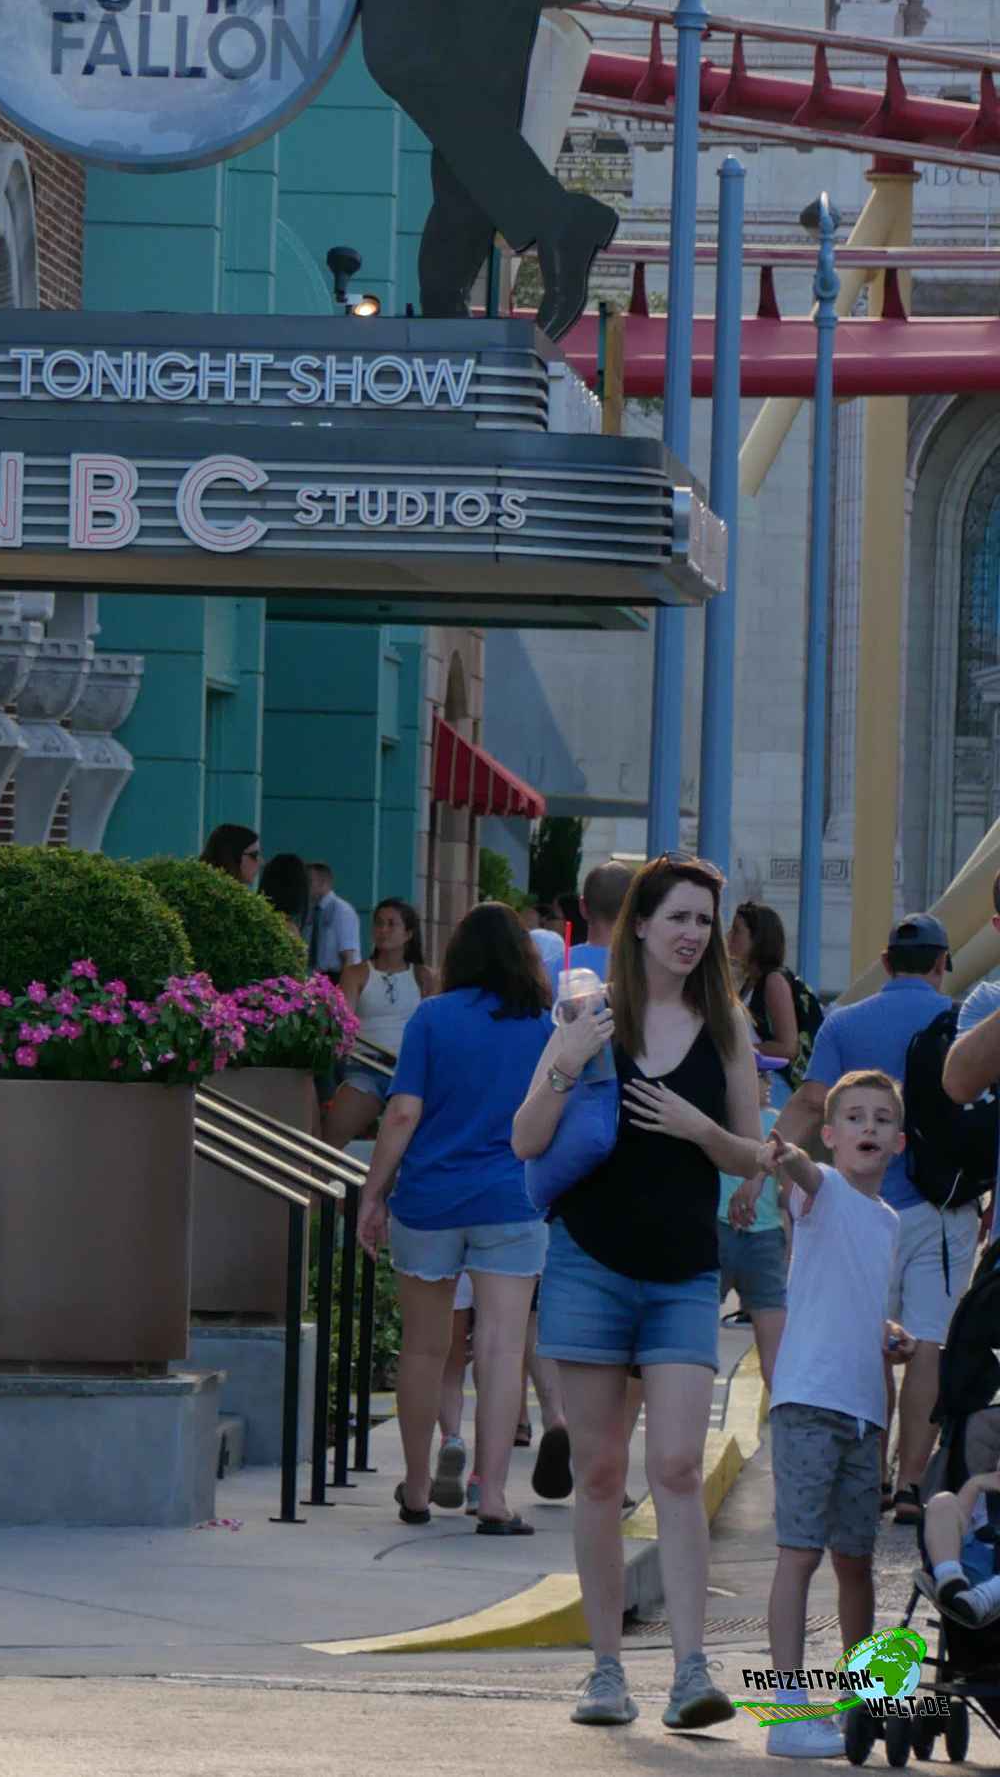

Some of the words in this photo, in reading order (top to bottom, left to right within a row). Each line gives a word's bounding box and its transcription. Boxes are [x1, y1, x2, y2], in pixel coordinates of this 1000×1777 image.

[52, 12, 321, 80] FALLON
[9, 348, 274, 401] TONIGHT
[286, 354, 476, 408] SHOW
[294, 486, 528, 530] STUDIOS
